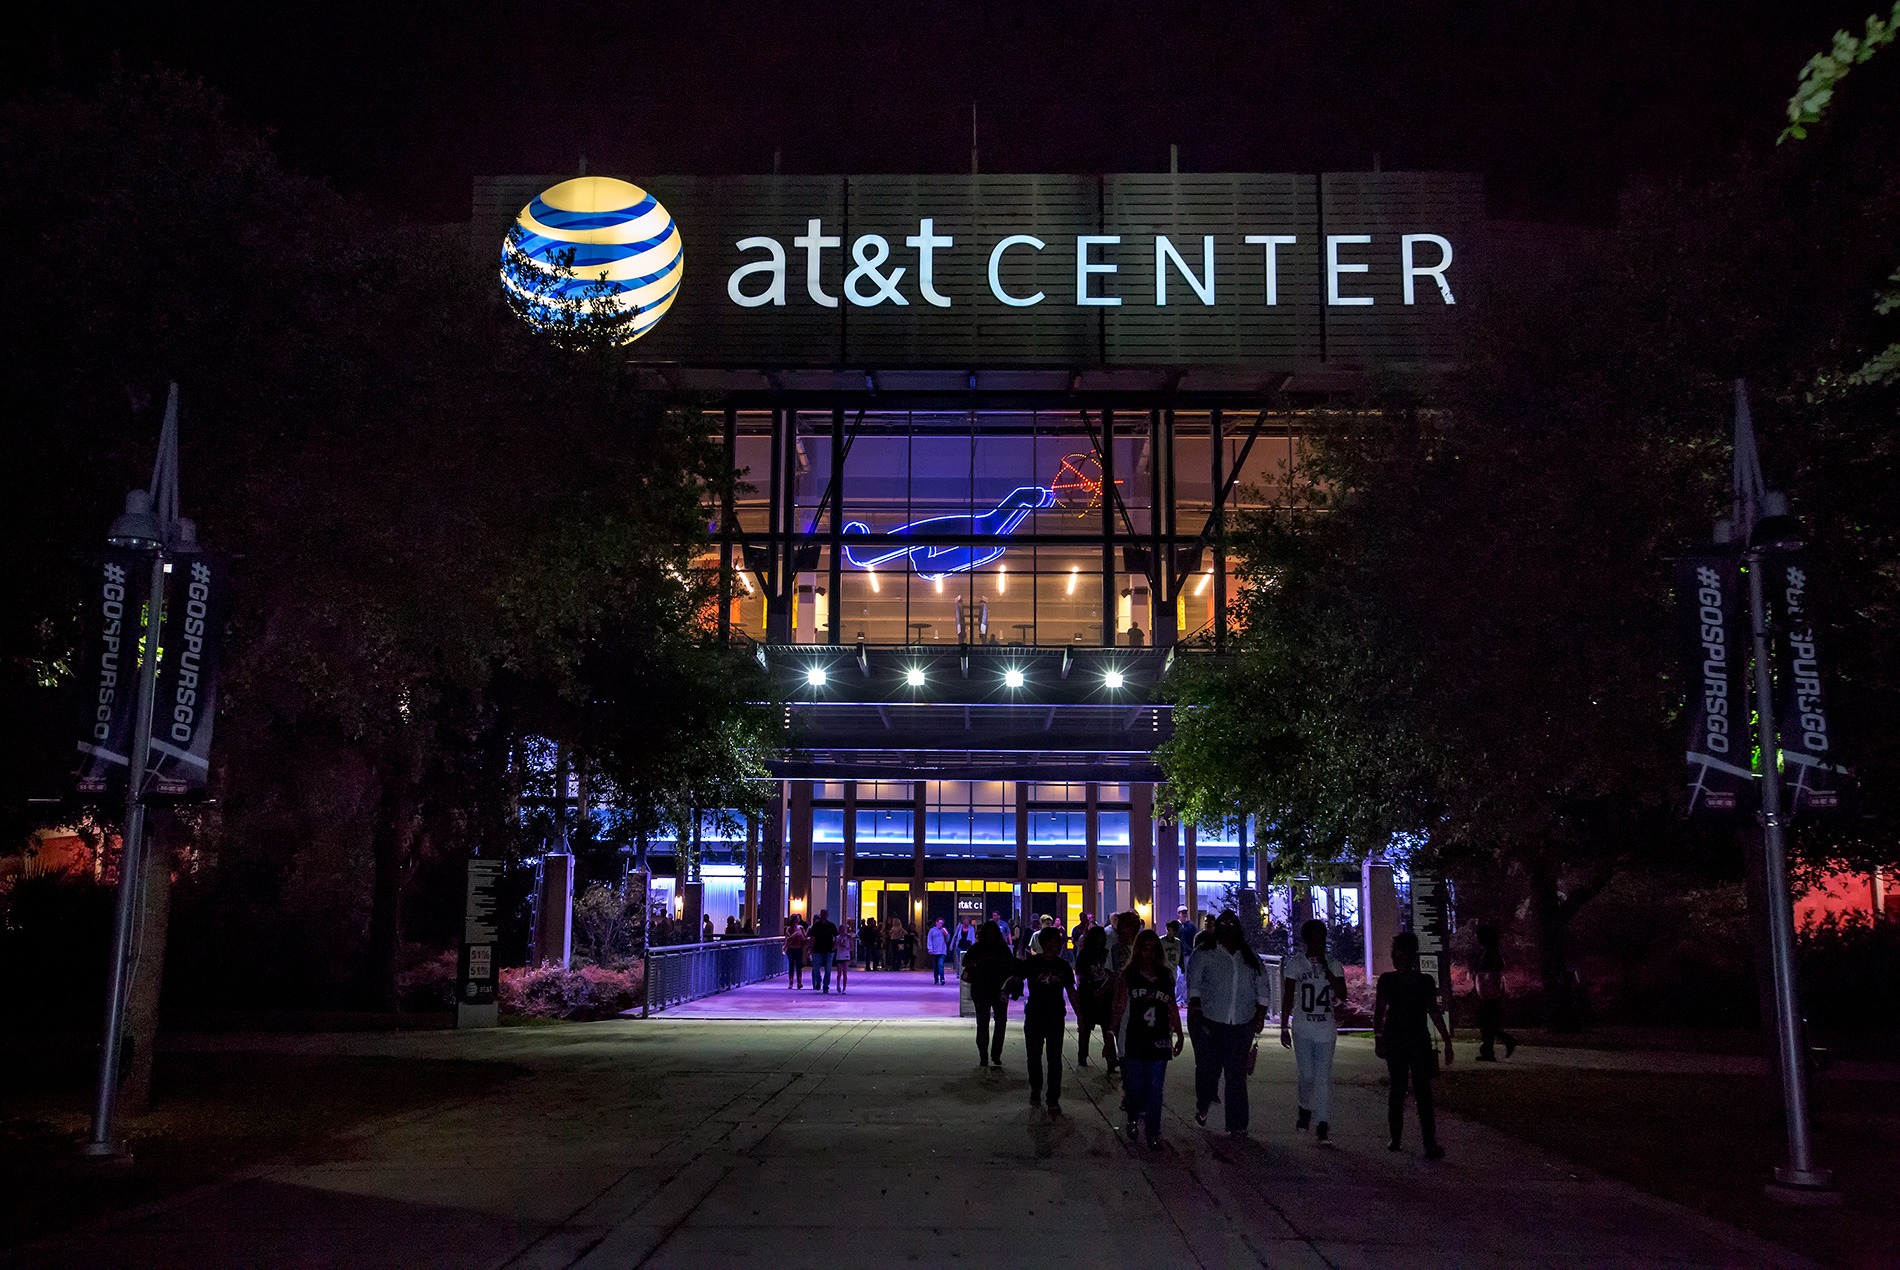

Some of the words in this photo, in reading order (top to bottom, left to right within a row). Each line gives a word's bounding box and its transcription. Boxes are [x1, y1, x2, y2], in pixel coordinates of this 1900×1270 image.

[727, 217, 954, 308] at&t
[988, 233, 1457, 307] CENTER
[93, 562, 126, 741] #GOSPURSGO
[171, 562, 211, 742] #GOSPURSGO
[1696, 565, 1730, 754] #GOSPURSGO
[1785, 565, 1829, 752] #GSPURSGO
[1131, 988, 1170, 1003] SPRS
[1143, 1006, 1156, 1028] 4
[1301, 983, 1331, 1014] 04
